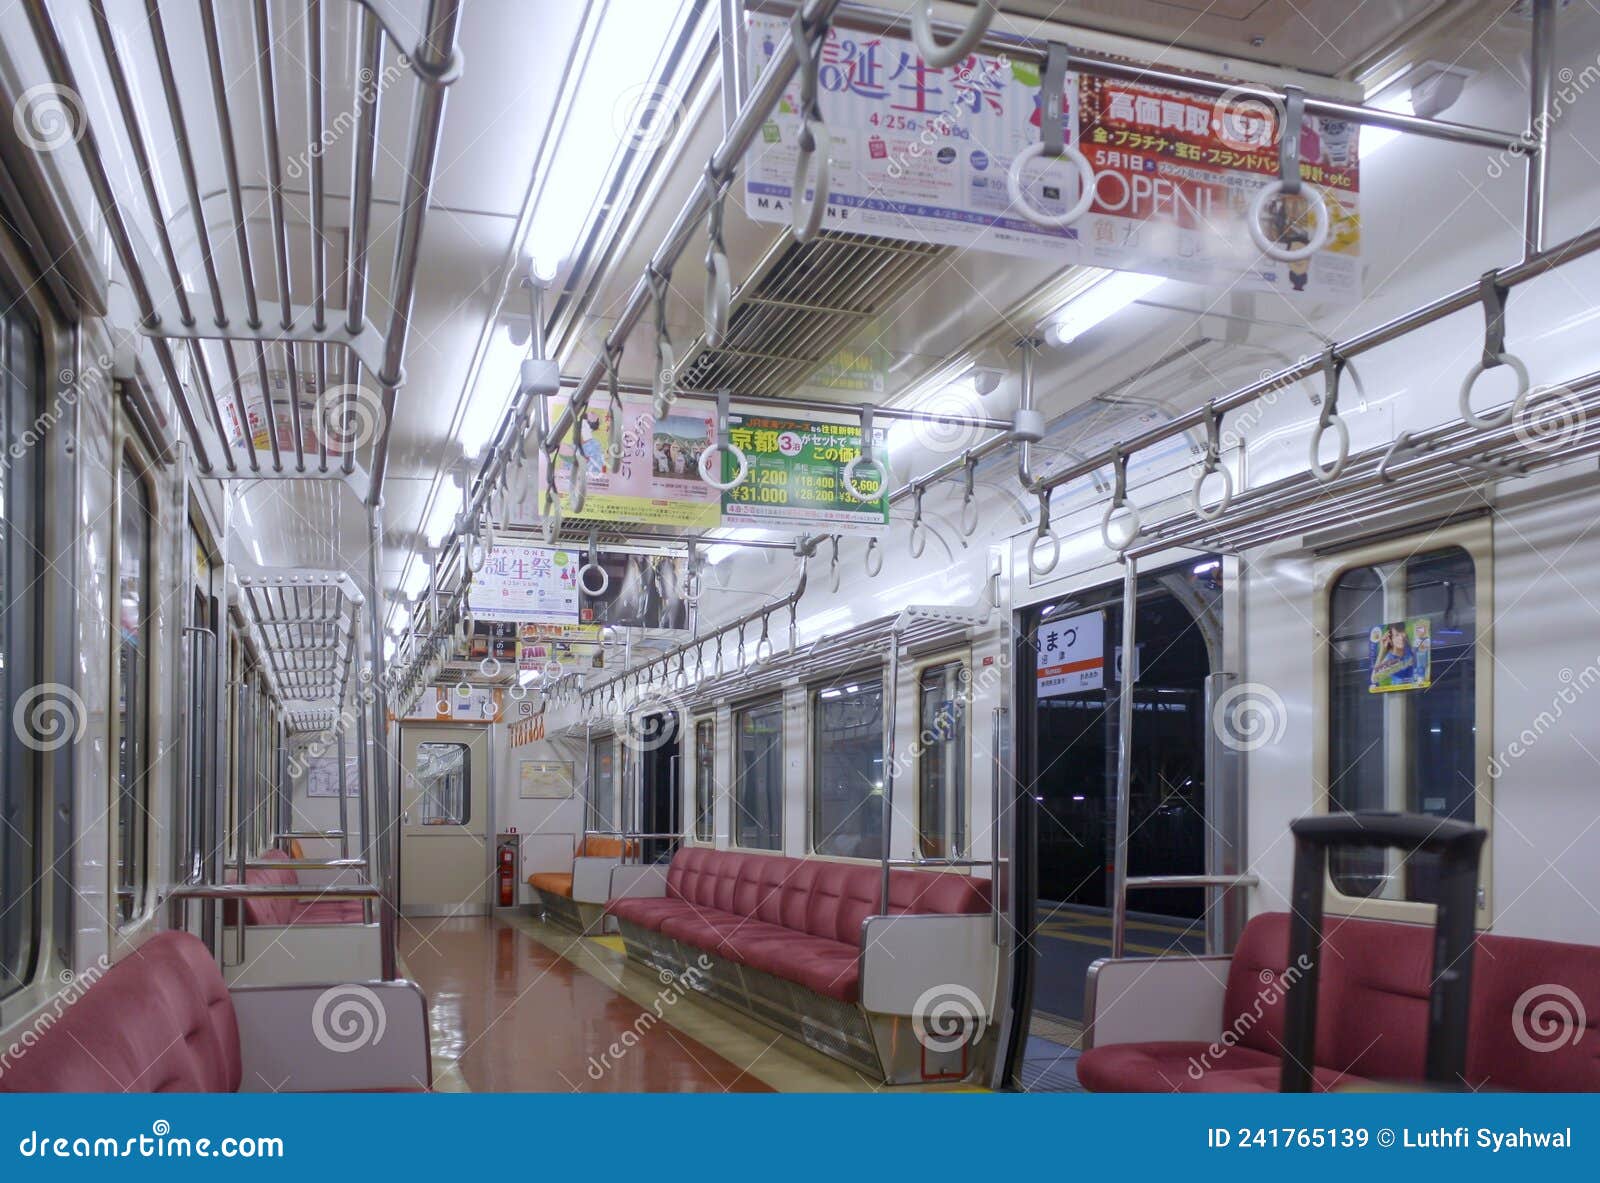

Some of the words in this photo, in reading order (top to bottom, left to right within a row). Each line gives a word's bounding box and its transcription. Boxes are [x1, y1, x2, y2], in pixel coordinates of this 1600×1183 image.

[819, 26, 1005, 119] 誕生祭
[485, 555, 552, 580] 誕生祭
